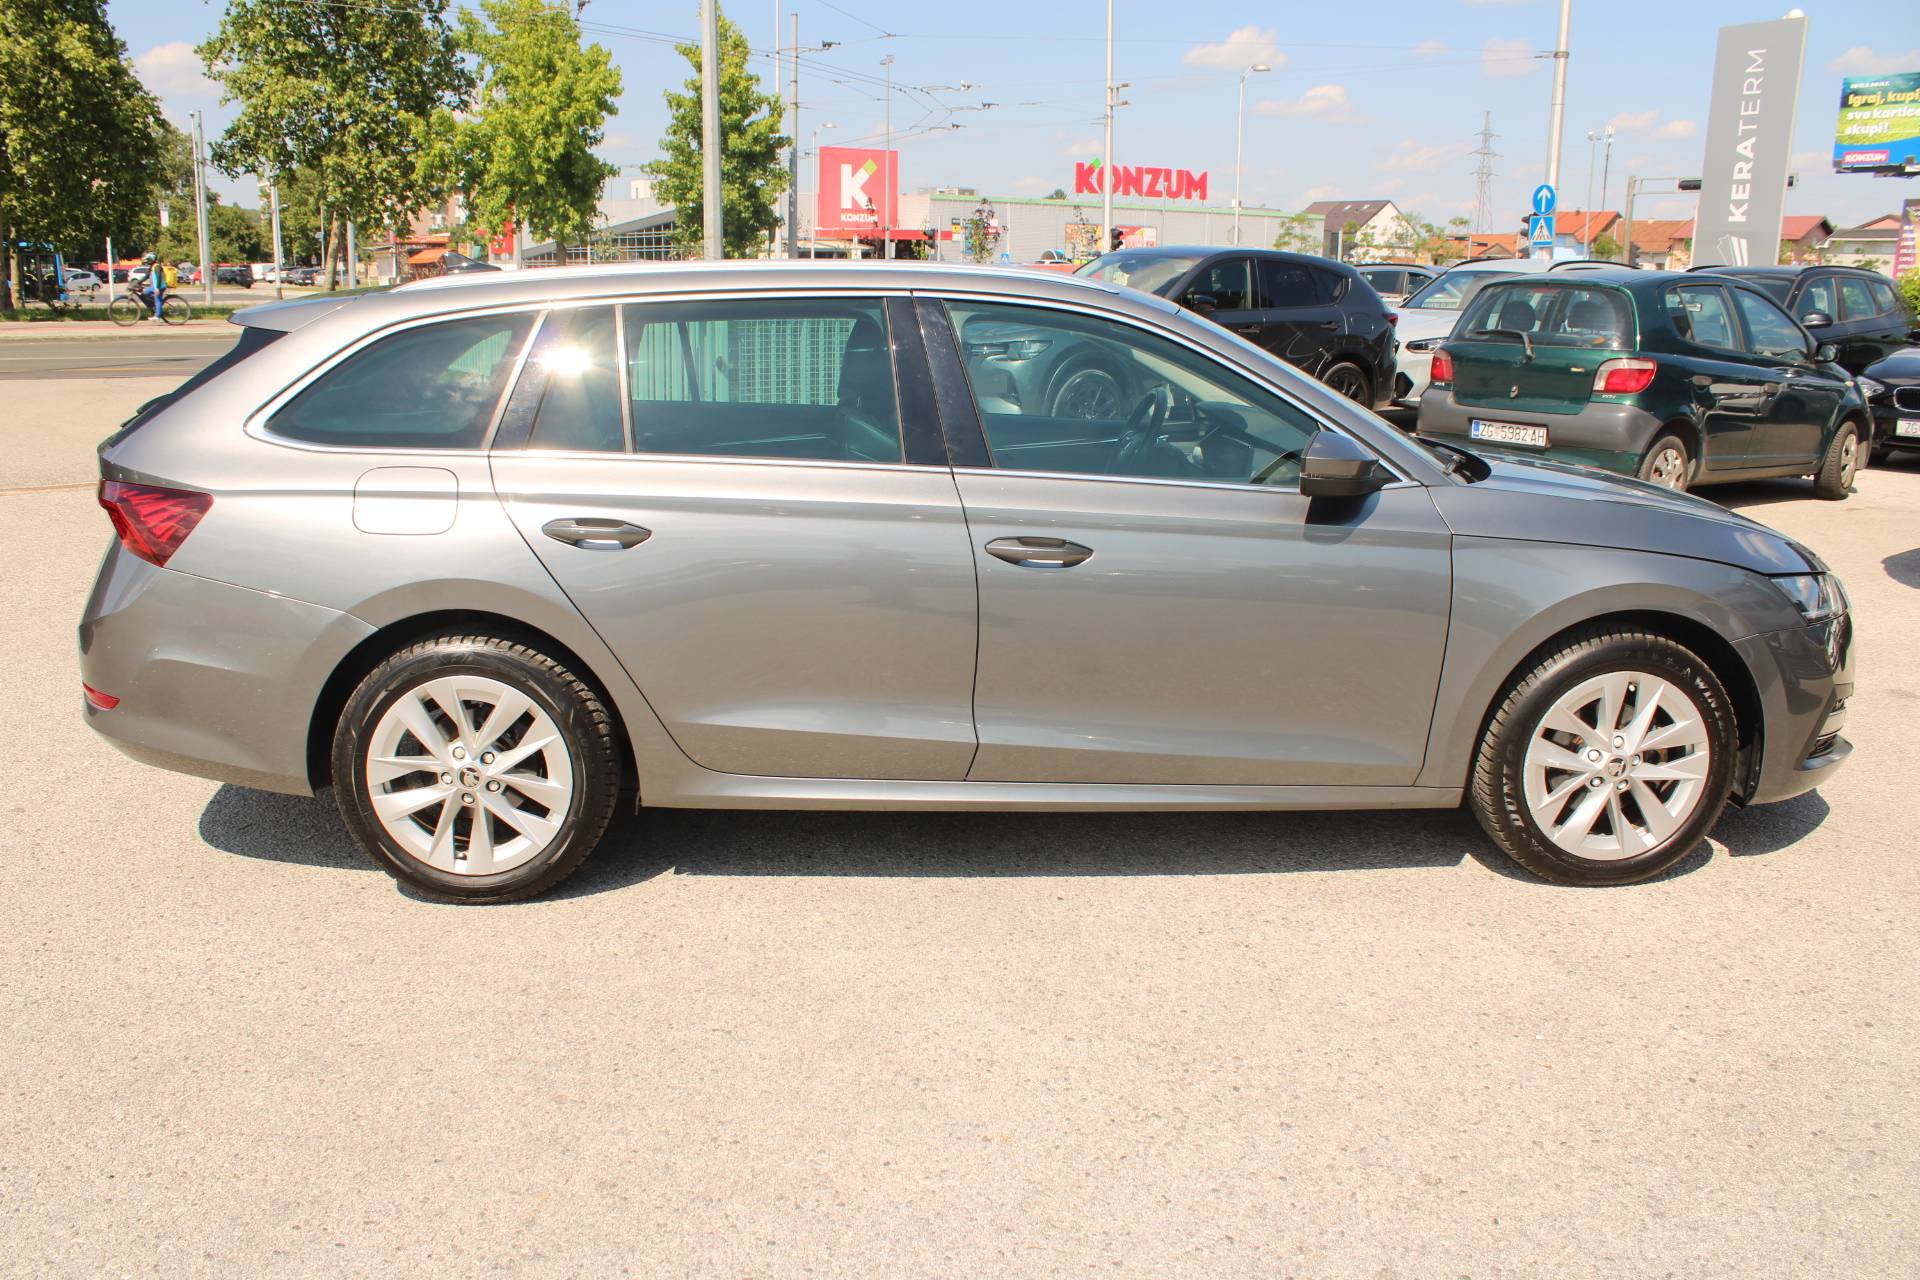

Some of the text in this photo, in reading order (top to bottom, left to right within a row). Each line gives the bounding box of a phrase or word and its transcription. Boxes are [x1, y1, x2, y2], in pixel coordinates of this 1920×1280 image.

[1728, 49, 1767, 223] KERATERM
[840, 159, 878, 210] K
[1075, 159, 1208, 201] KONZUM
[840, 212, 879, 223] KONZUM
[1480, 423, 1494, 437] ZG
